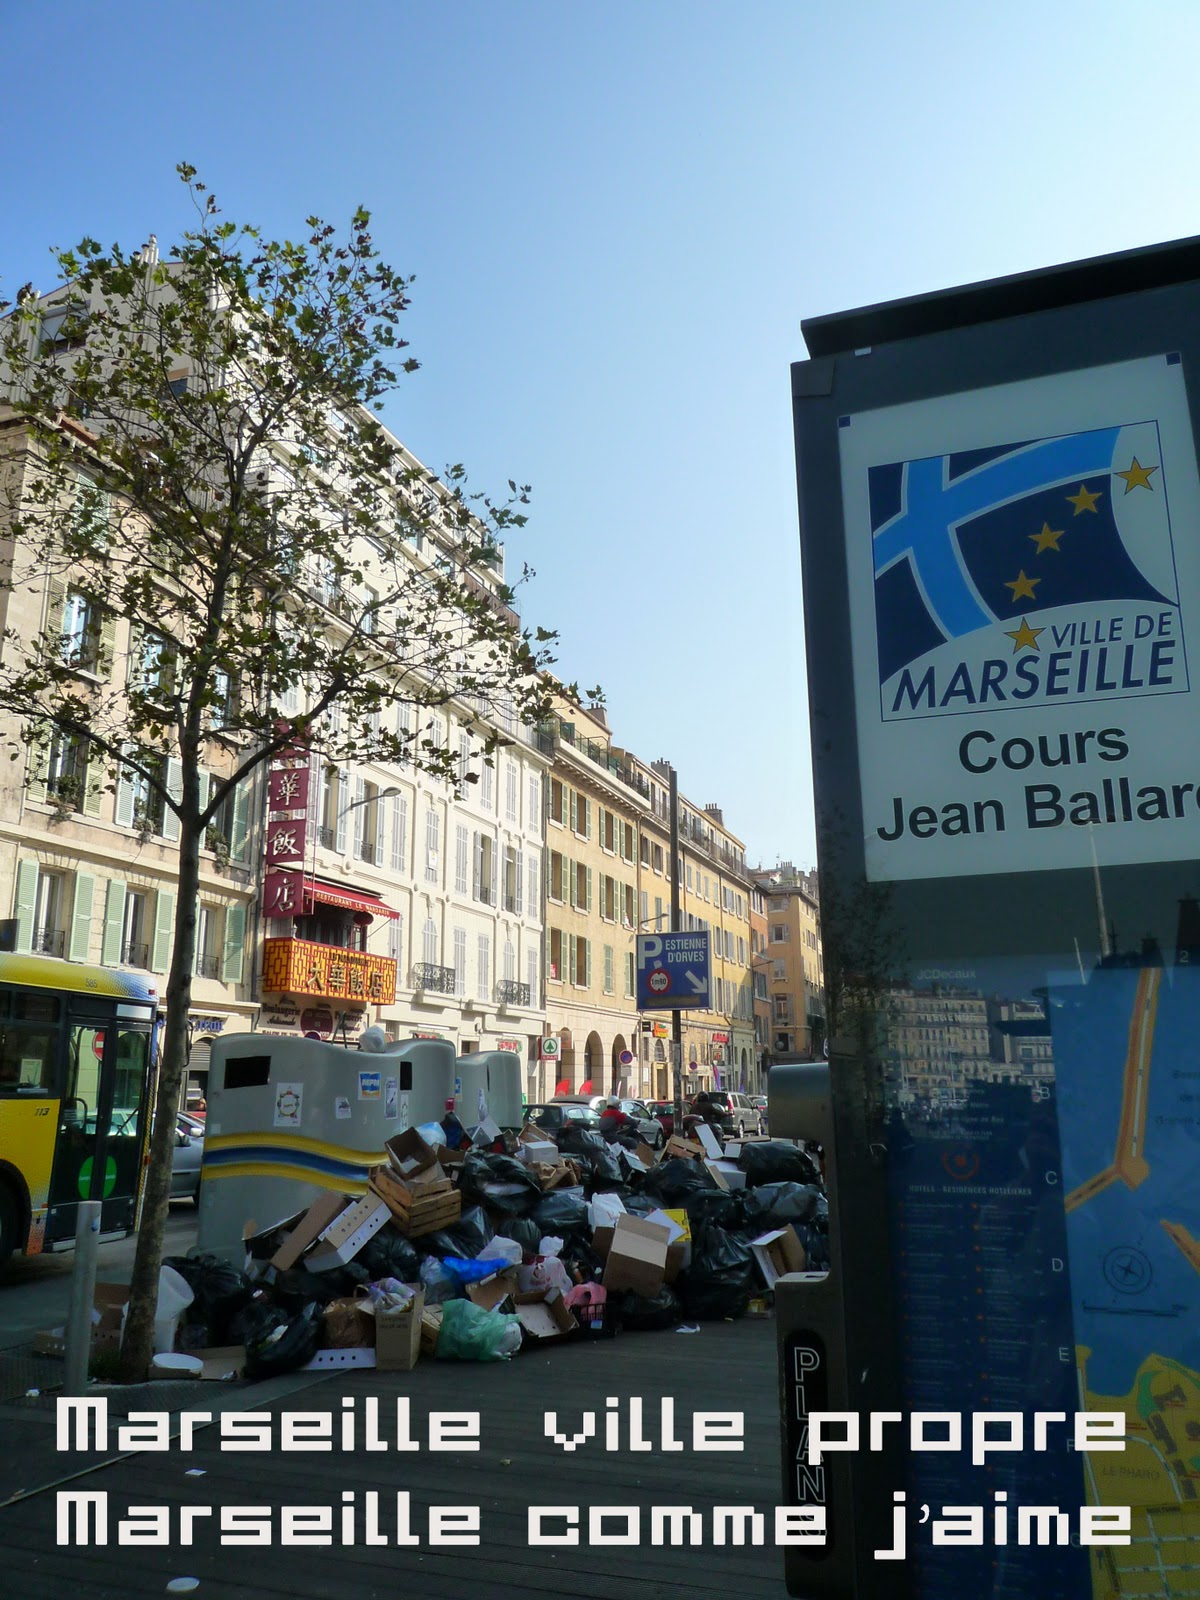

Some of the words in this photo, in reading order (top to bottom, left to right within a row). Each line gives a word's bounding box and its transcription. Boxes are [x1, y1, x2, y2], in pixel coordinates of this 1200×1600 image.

[1051, 616, 1124, 649] VILLE
[1134, 611, 1173, 640] DE
[891, 639, 1177, 712] MARSEILLE
[958, 725, 1130, 774] Cours
[876, 796, 1006, 842] Jean
[316, 892, 353, 907] RESTAURANT
[355, 902, 363, 910] LE
[638, 934, 663, 970] P
[665, 938, 707, 951] ESTIENNE
[668, 951, 704, 963] D'ORVES
[1180, 950, 1189, 963] 2
[916, 968, 977, 981] JCDecaux
[1040, 1086, 1051, 1100] B
[1045, 1170, 1058, 1185] C
[908, 1185, 935, 1193] HOTELS
[942, 1185, 987, 1195] RESIDENCES
[1051, 1257, 1064, 1273] D
[1058, 1347, 1070, 1362] E
